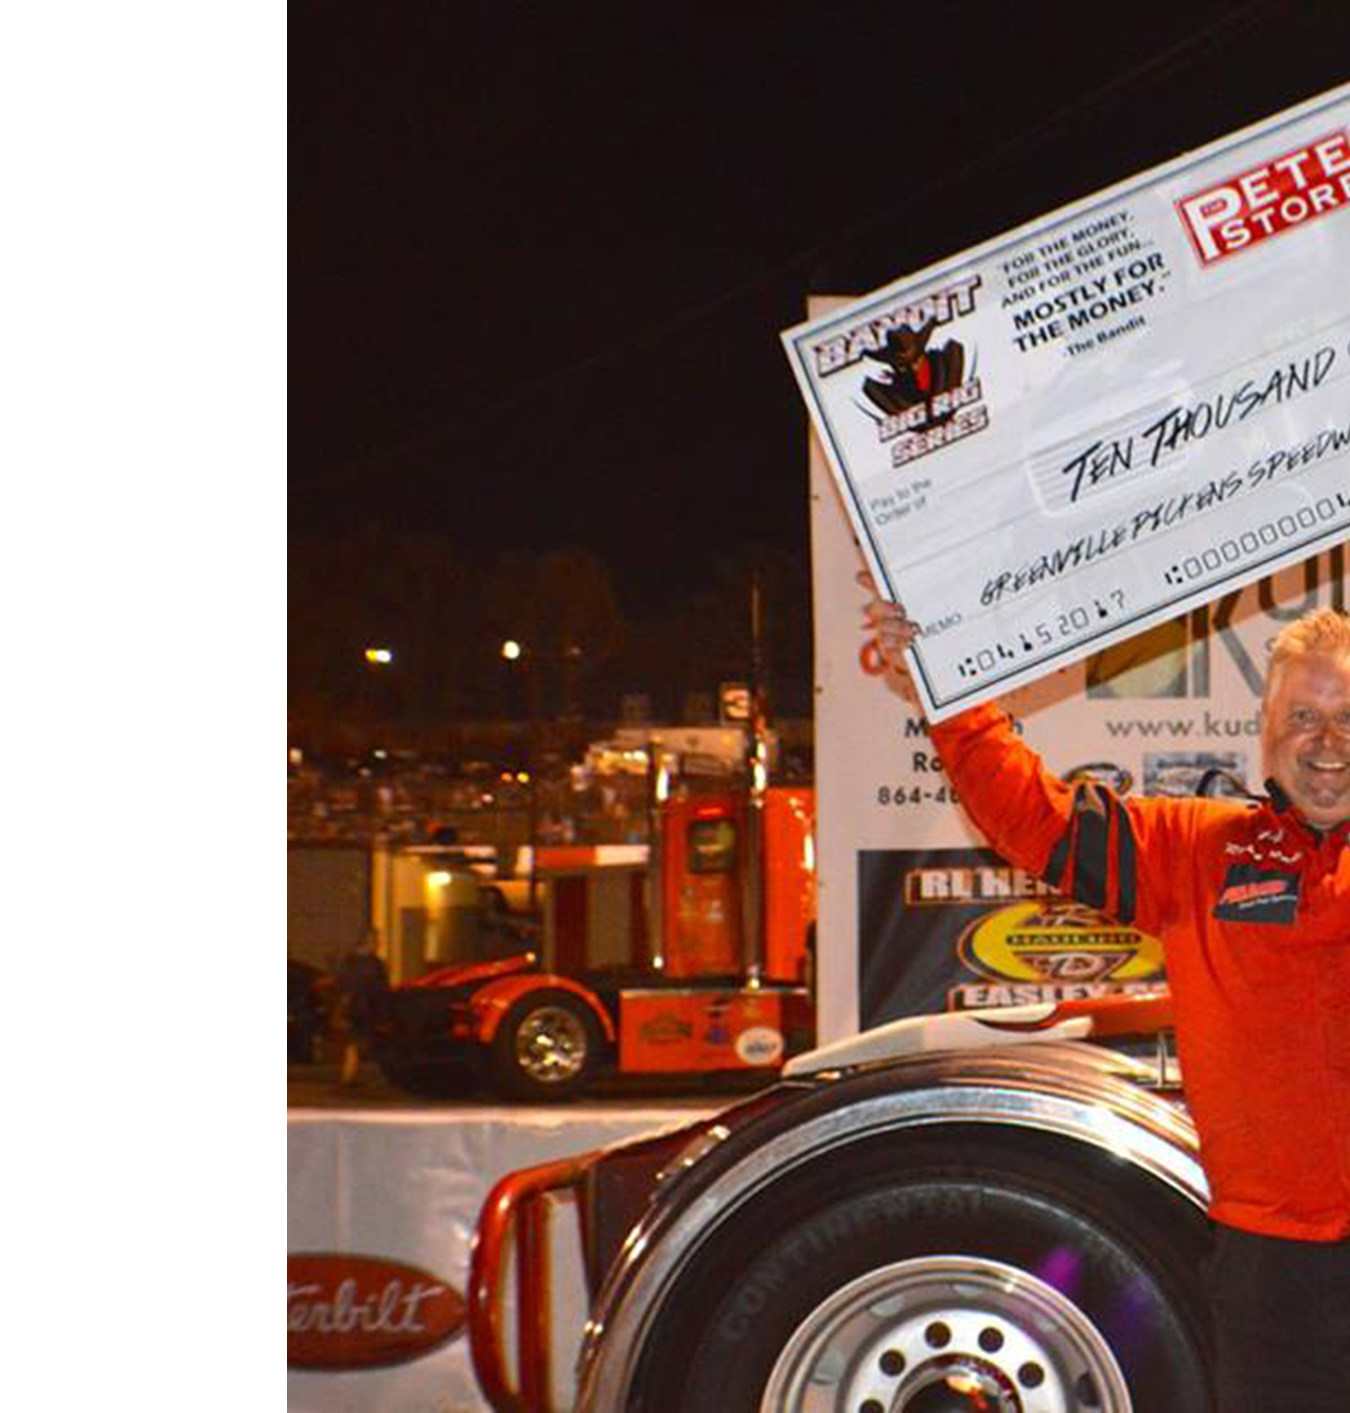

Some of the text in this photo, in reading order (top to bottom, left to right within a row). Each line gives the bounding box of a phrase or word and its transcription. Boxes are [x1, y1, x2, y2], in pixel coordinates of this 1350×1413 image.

[1007, 266, 1040, 289] FOR
[1045, 253, 1076, 273] THE
[1039, 238, 1070, 258] THE
[1001, 287, 1036, 310] AND
[1039, 271, 1071, 292] FOR
[1074, 257, 1106, 277] THE
[1013, 252, 1166, 331] MOSTLY FOR
[815, 275, 982, 378] BANDIT
[1013, 321, 1065, 353] THE
[1096, 315, 1147, 344] Bandit
[1063, 438, 1133, 502] TEN
[1142, 347, 1336, 466] THOUSAND
[980, 527, 1127, 605] GREENVILLE
[1131, 470, 1243, 540] PICKENS
